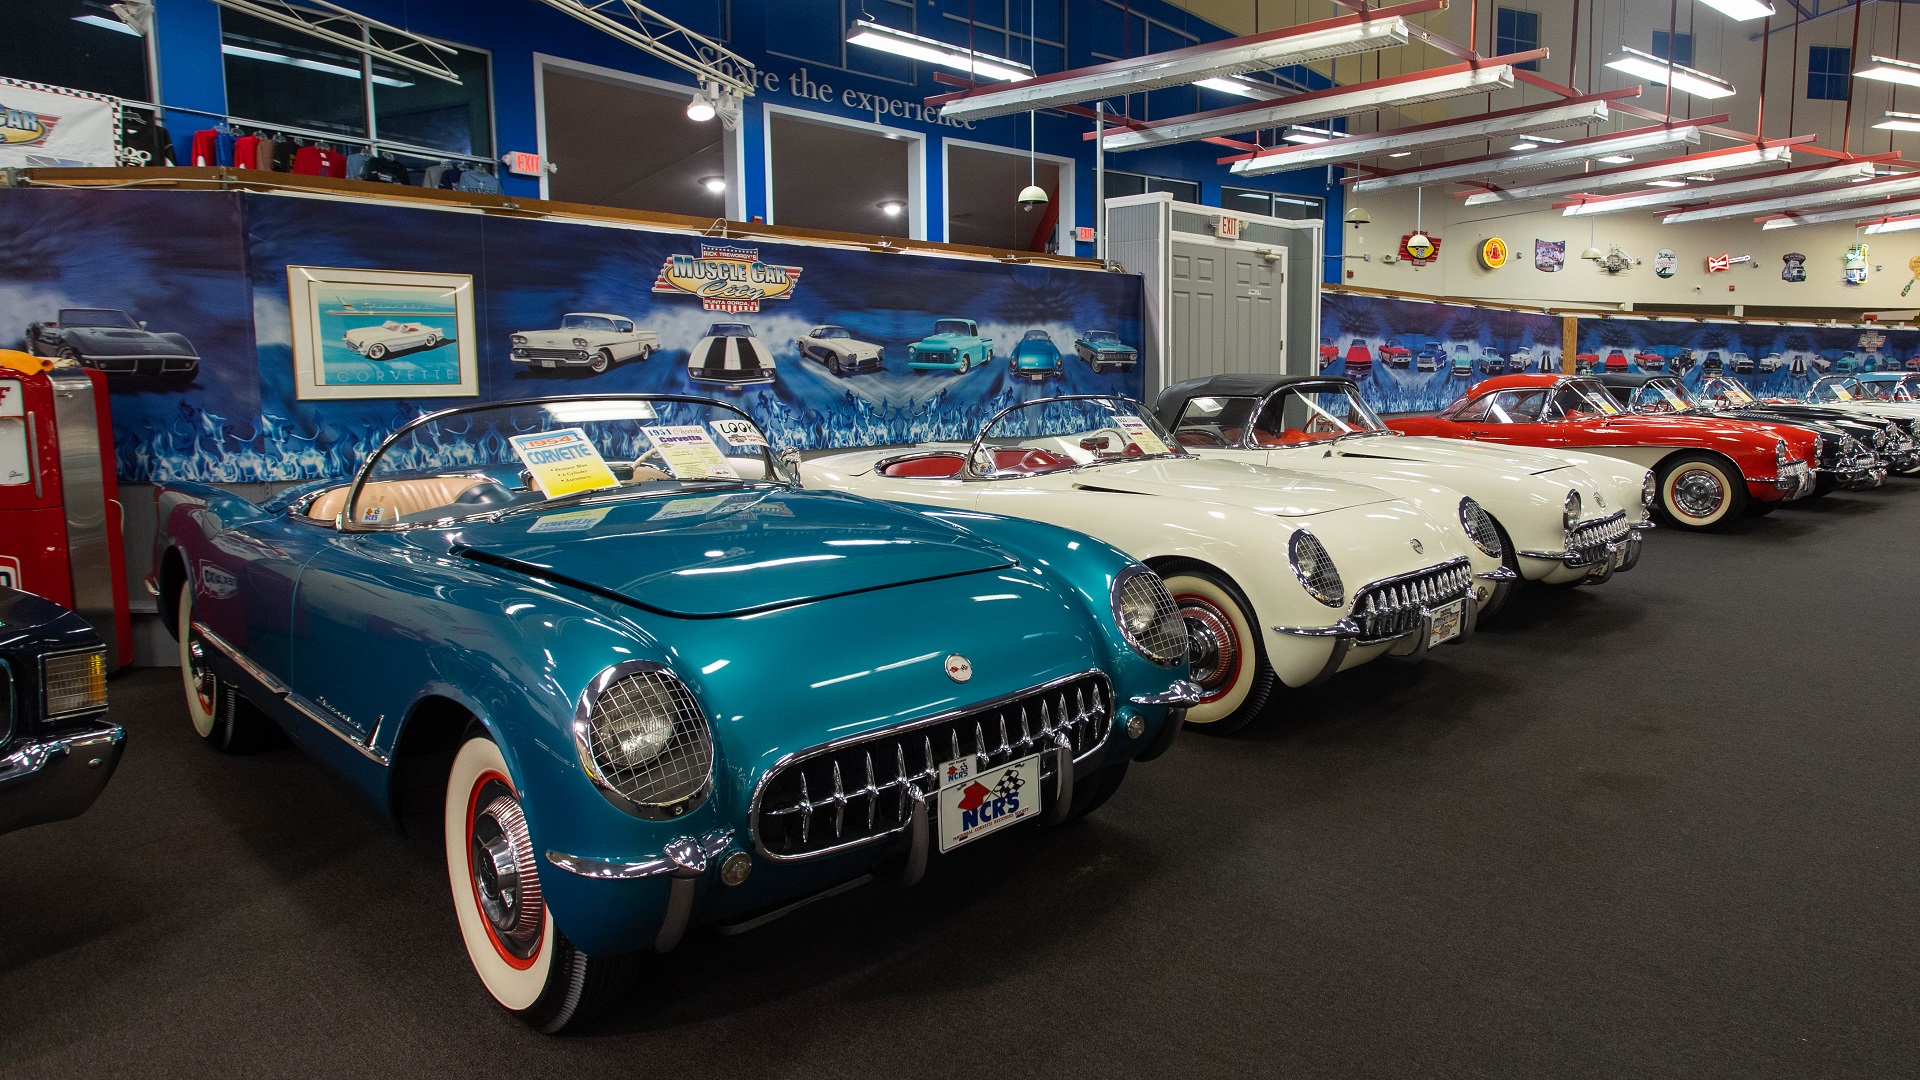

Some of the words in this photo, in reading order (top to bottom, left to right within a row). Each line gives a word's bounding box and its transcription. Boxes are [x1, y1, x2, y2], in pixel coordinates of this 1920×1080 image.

[790, 67, 833, 103] the
[516, 153, 540, 173] EXIT
[1080, 228, 1093, 240] EXIT
[1222, 216, 1237, 236] EXIT
[673, 255, 747, 282] MUSCLE
[751, 262, 787, 285] CAR
[696, 280, 766, 301] City
[337, 369, 455, 383] CORVETTE
[719, 422, 757, 434] LOOK
[528, 435, 572, 447] 1954
[659, 435, 702, 443] Corvette
[526, 443, 592, 465] CORVETTE
[947, 770, 968, 782] NCRS
[962, 792, 1020, 832] NCRS
[953, 829, 973, 841] NATIONAL
[974, 821, 993, 832] CORVETTE
[1015, 806, 1030, 816] SOCIETY
